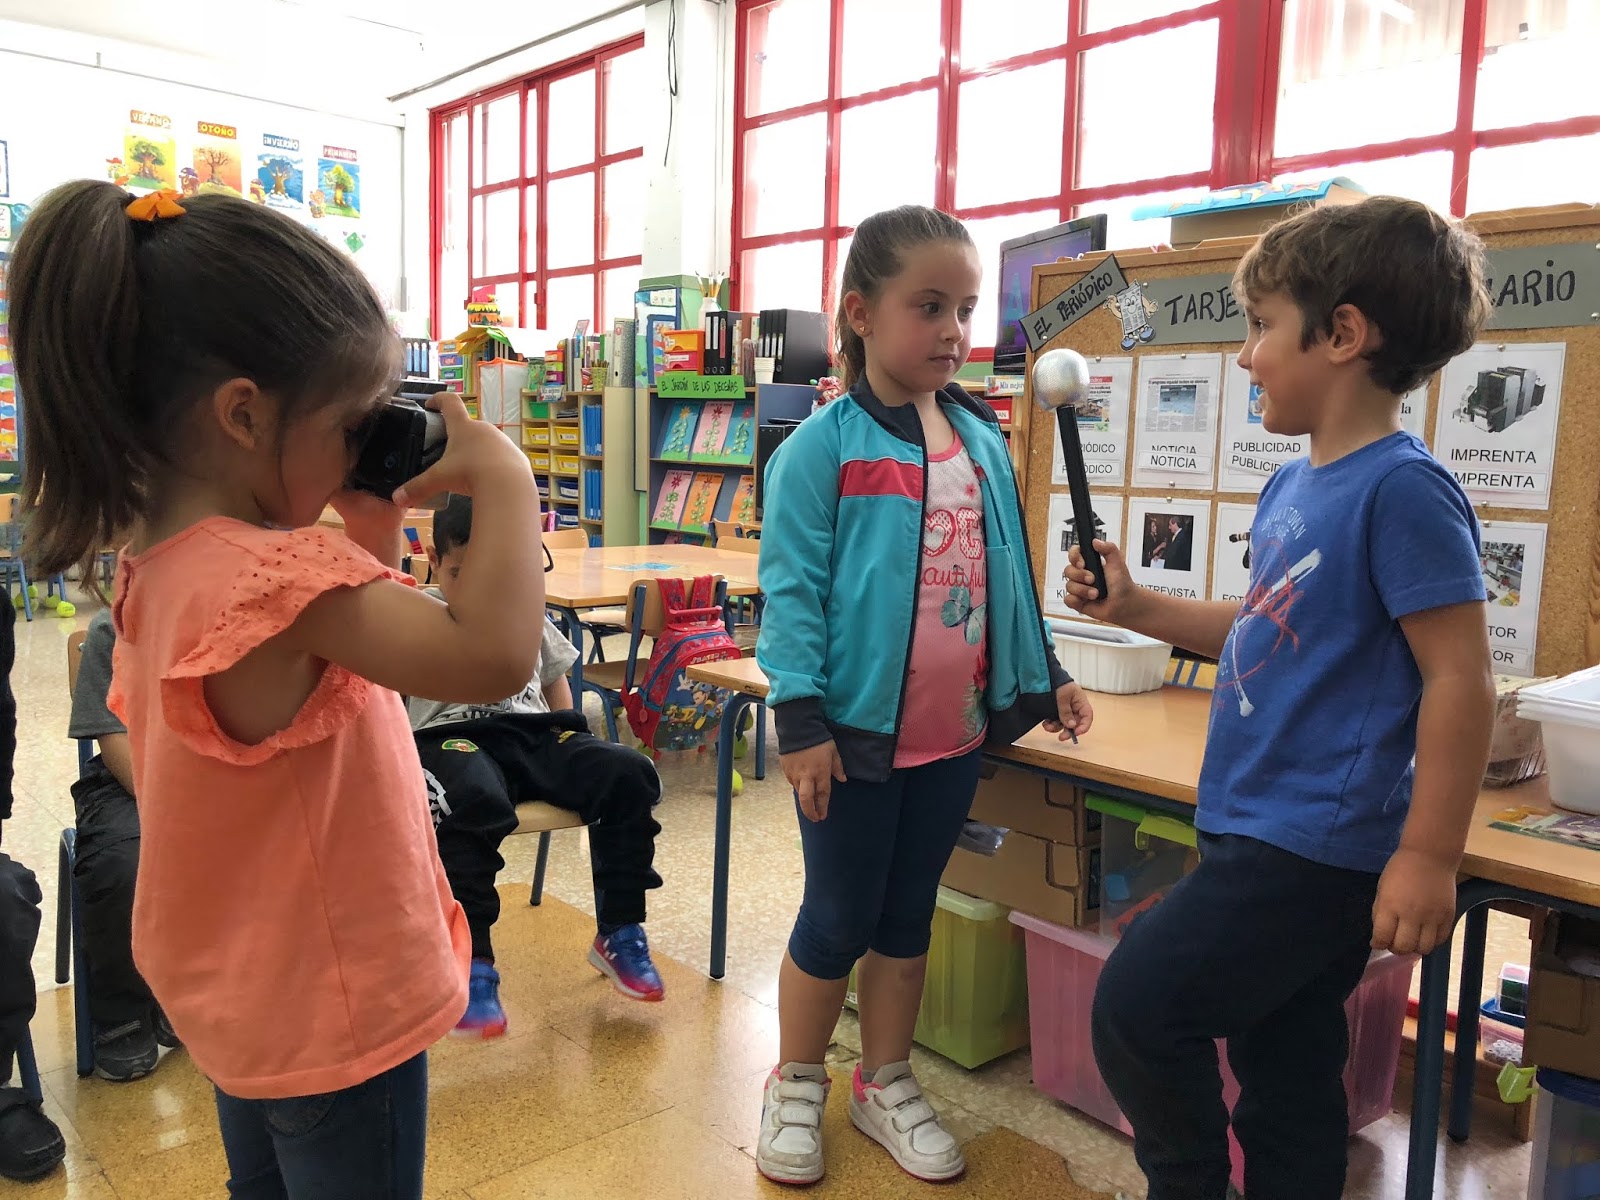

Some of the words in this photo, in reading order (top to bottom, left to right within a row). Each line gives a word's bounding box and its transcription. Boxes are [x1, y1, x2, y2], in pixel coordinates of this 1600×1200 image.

[1164, 286, 1241, 326] TARJE
[1033, 316, 1053, 340] EL
[661, 381, 668, 392] EL
[1080, 441, 1116, 453] IÓDICO
[1233, 441, 1301, 452] PUBLICIDAD
[1150, 454, 1197, 469] NOTICIA
[1231, 454, 1281, 473] PUBLICID
[1450, 448, 1537, 464] IMPRENTA
[1062, 463, 1113, 474] PÓDICO
[1452, 471, 1535, 489] MPRENTA
[922, 562, 985, 597] autiful
[1137, 584, 1197, 599] REVISTA
[1487, 625, 1517, 639] TOR
[1491, 649, 1514, 664] OR
